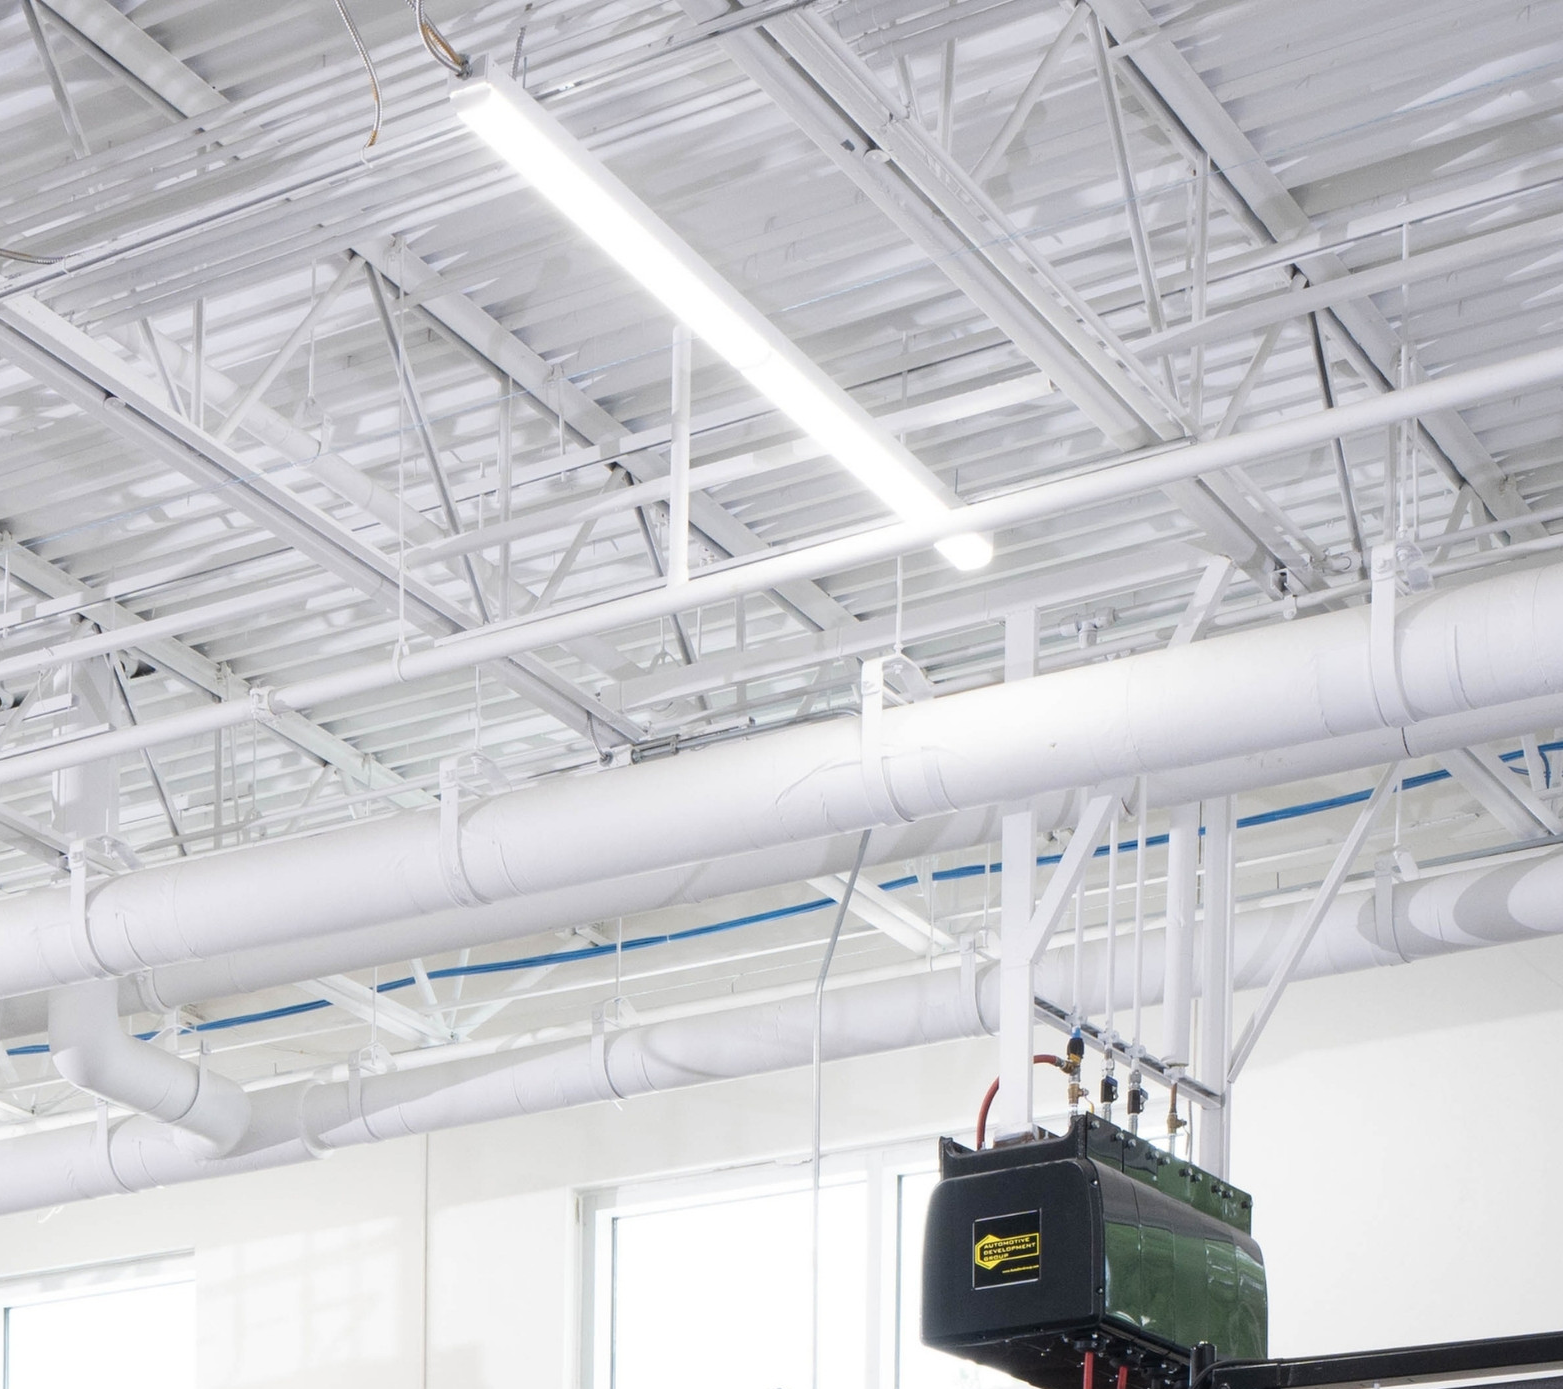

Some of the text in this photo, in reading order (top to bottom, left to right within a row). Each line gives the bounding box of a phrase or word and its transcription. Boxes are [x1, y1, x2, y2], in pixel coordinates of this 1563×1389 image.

[983, 1237, 1030, 1249] AUTOMOTIVE
[983, 1242, 1036, 1255] DEVELOPMENT
[983, 1253, 1009, 1262] GROUP
